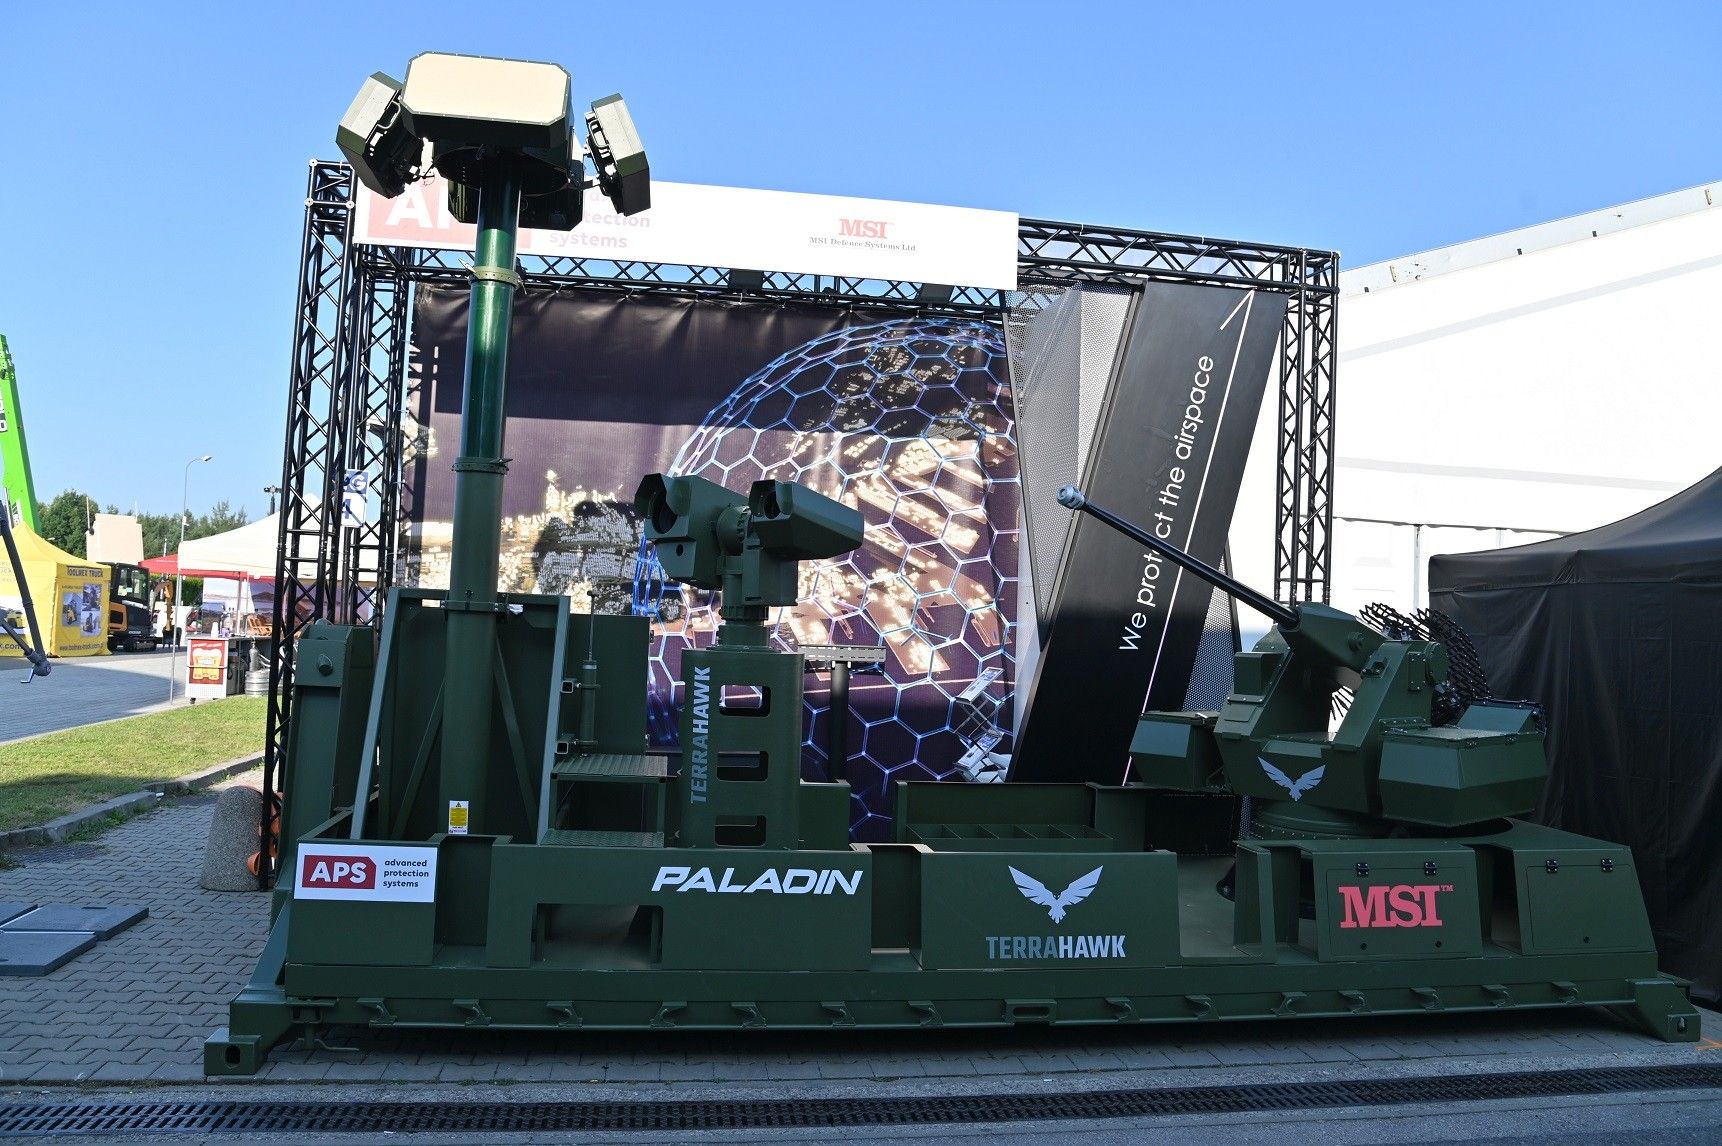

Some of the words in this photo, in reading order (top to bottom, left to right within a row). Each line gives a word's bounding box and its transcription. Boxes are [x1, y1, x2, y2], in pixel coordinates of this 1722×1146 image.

[583, 211, 651, 228] tection
[838, 218, 888, 239] MSI
[550, 232, 628, 249] systems
[809, 236, 828, 245] MSI
[830, 238, 863, 248] Defence
[864, 240, 900, 251] Systems
[902, 243, 916, 252] Ltd
[1173, 355, 1214, 461] airspace
[1154, 465, 1186, 508] the
[1136, 511, 1175, 607] protct
[1119, 611, 1147, 651] We
[690, 666, 711, 804] TERRAHAWK
[309, 861, 367, 884] APS
[383, 869, 429, 878] protection
[384, 858, 428, 867] advanced
[382, 879, 419, 888] systems
[651, 866, 864, 896] PALADIN
[985, 935, 1126, 960] TERRAHAWK
